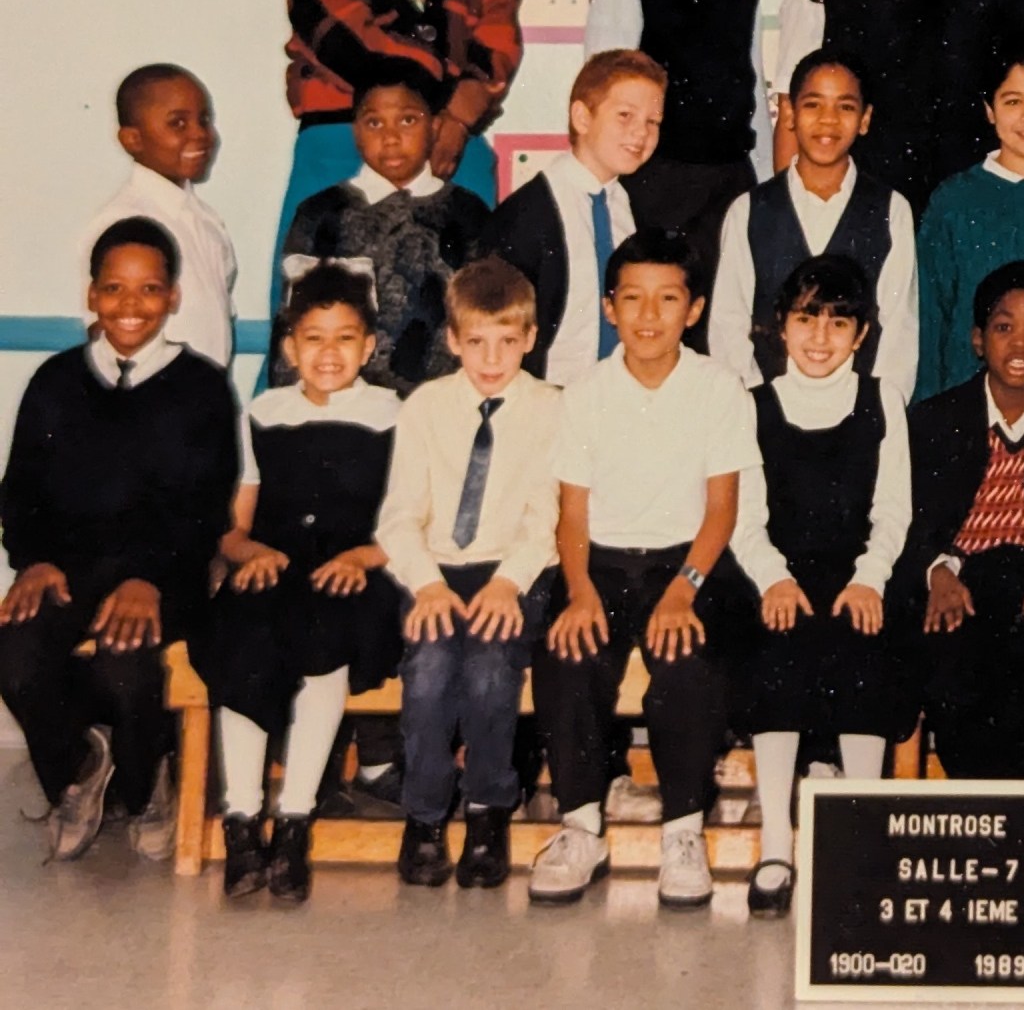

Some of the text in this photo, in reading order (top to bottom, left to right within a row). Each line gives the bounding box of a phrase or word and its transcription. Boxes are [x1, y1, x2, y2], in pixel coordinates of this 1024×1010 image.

[888, 814, 1007, 837] MONTROSE
[880, 899, 1018, 922] 3 ET 4 IEME
[830, 953, 927, 975] 1900-020
